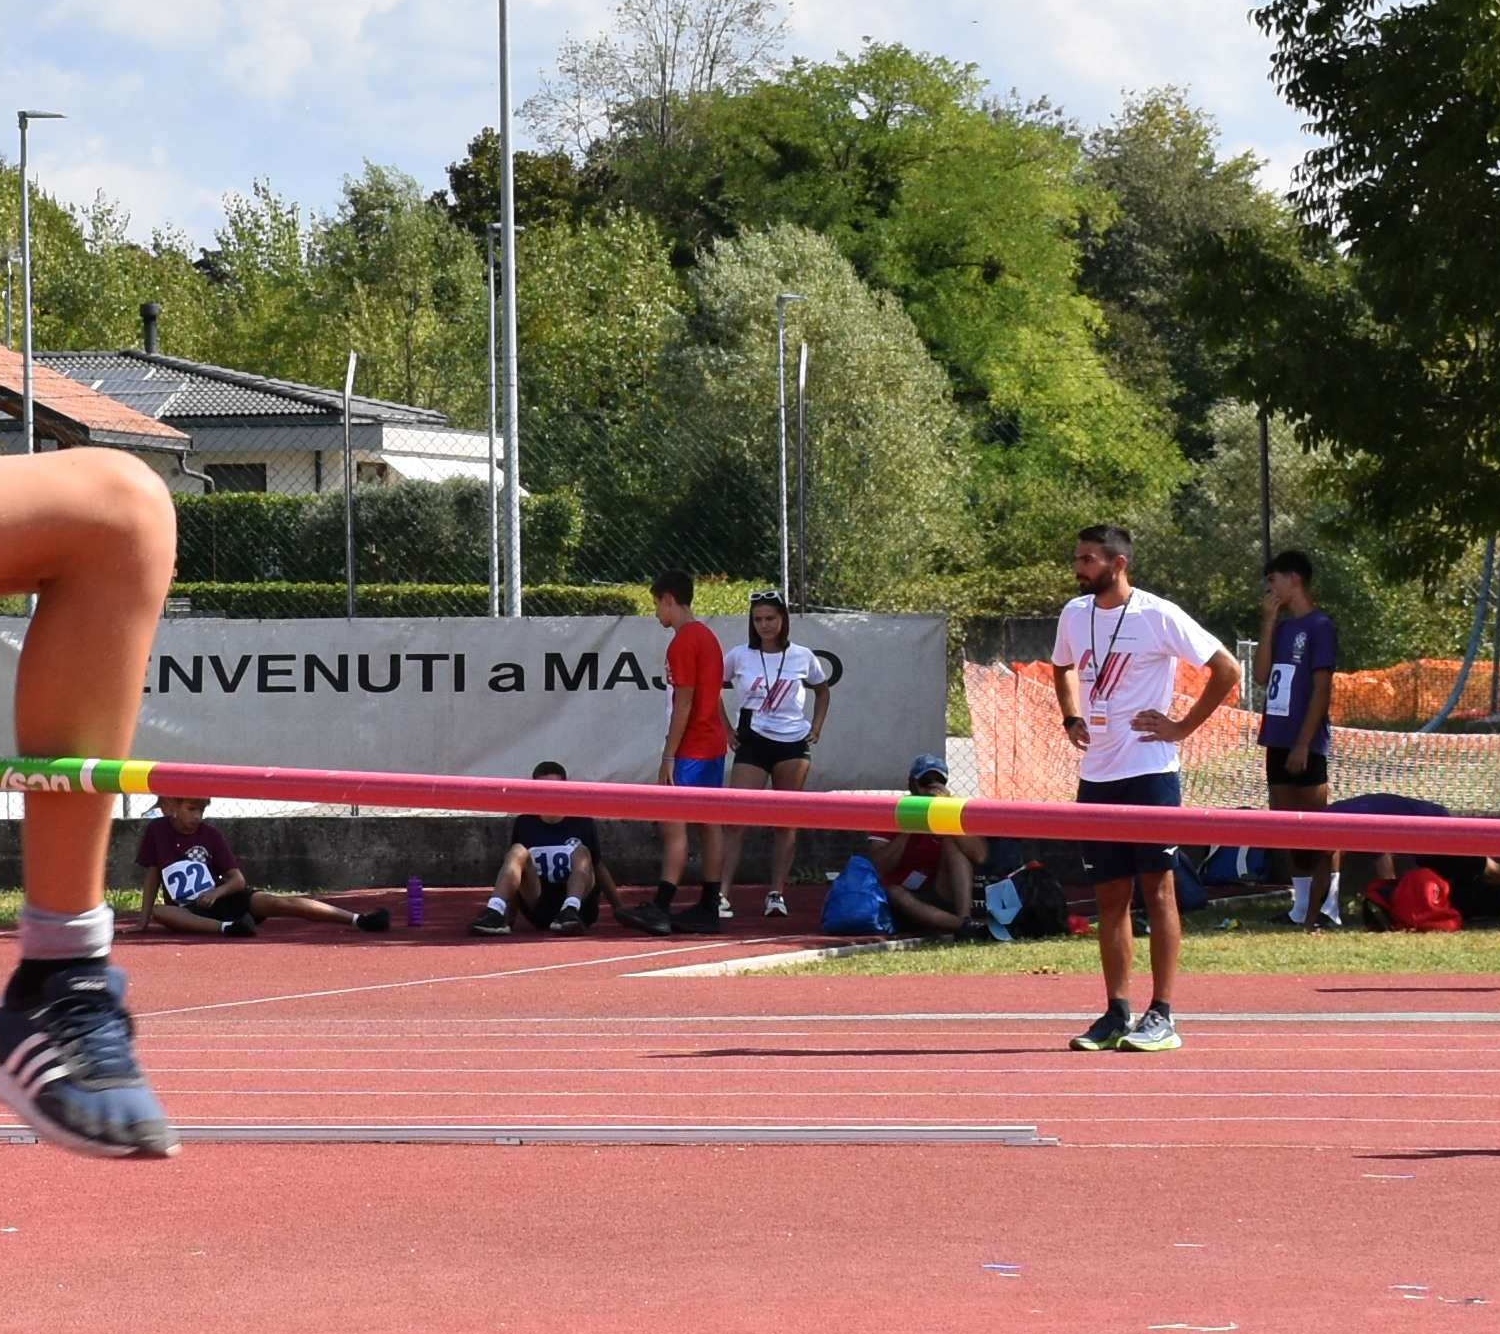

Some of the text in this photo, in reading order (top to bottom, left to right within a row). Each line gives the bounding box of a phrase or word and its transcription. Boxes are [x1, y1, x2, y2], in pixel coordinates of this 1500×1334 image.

[143, 653, 466, 694] NVENUTI
[487, 662, 526, 693] a
[167, 863, 213, 901] 22
[534, 852, 570, 882] 18
